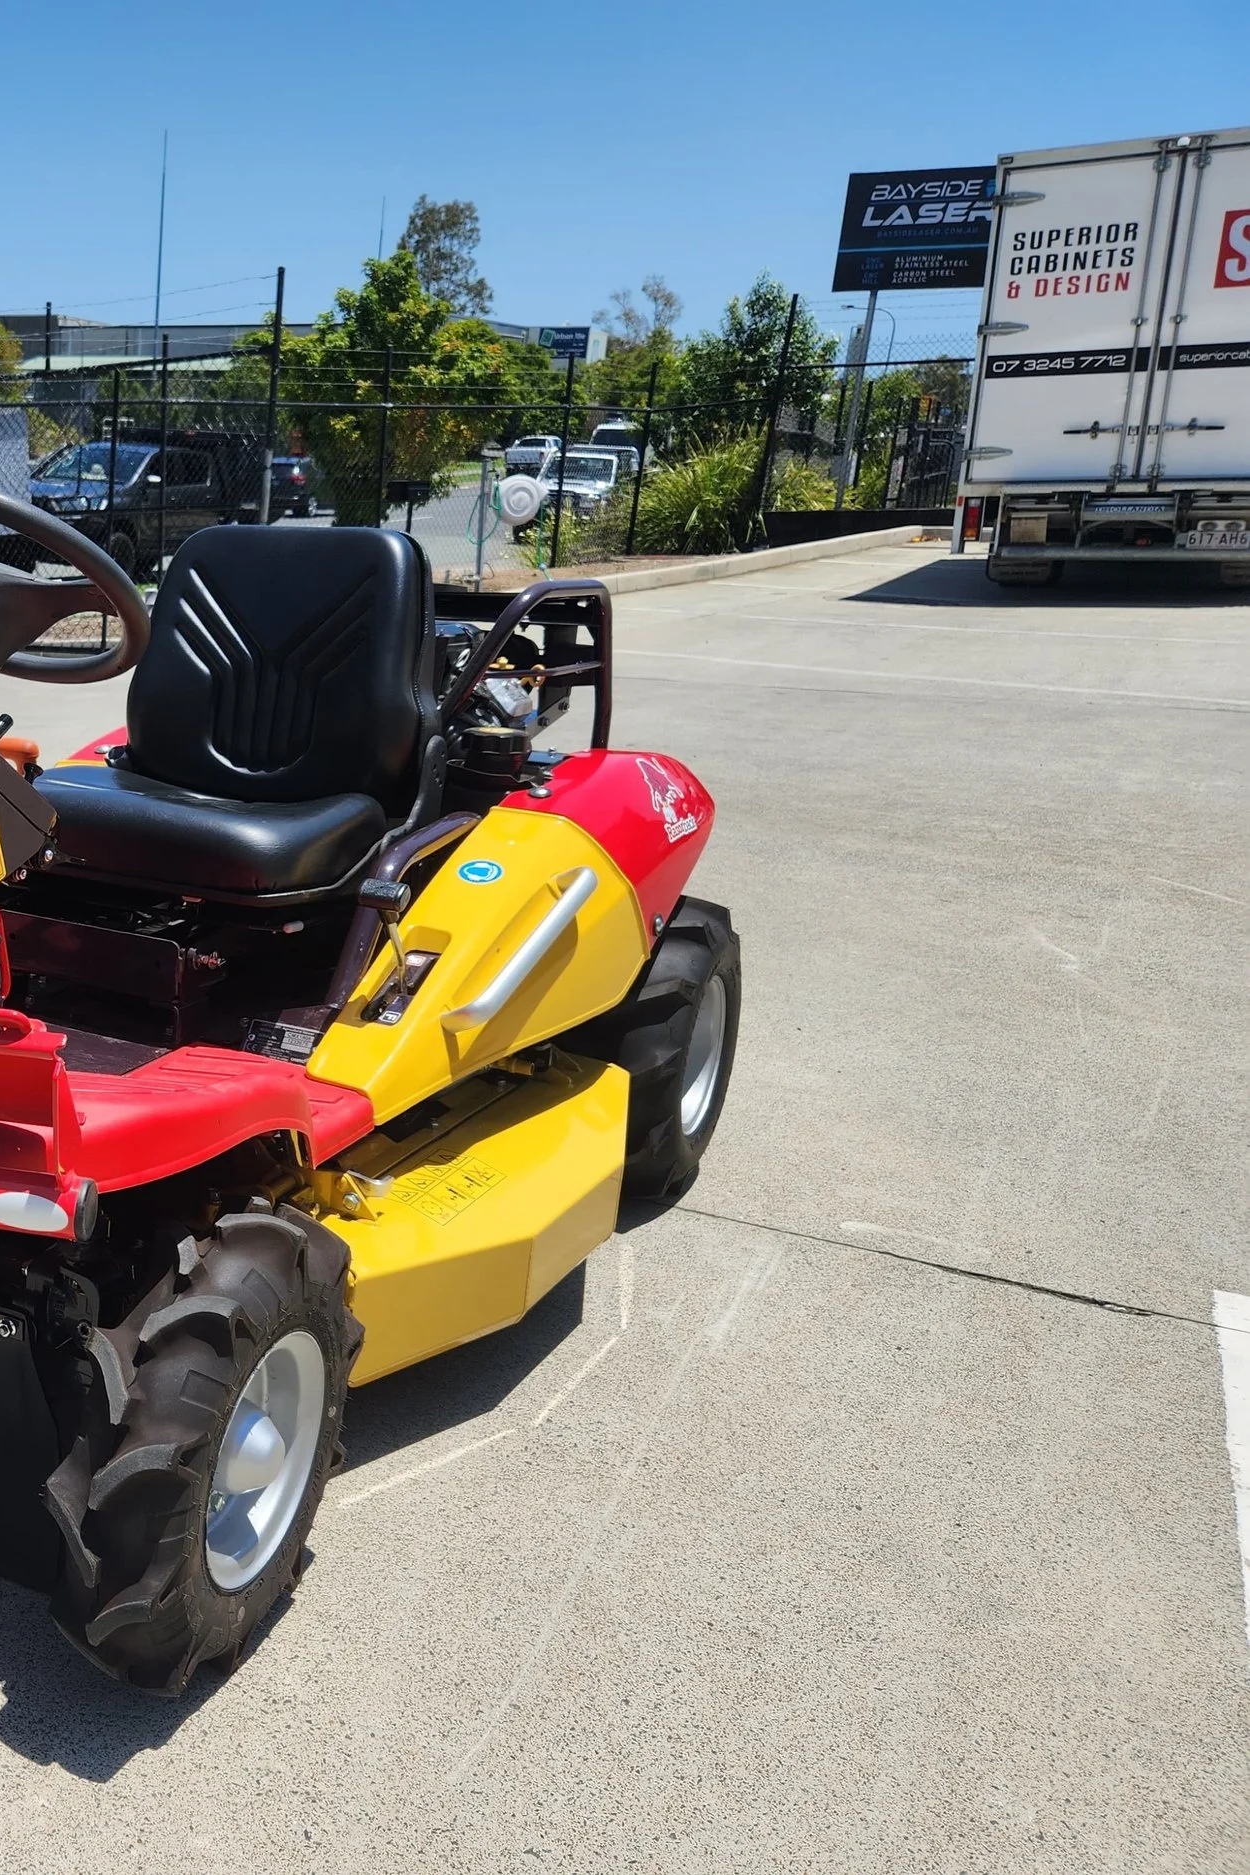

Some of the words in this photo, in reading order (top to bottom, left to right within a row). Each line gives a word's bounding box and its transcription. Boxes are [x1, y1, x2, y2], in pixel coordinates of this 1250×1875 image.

[870, 179, 984, 201] BAYSIDE
[862, 201, 994, 228] LASER
[1013, 222, 1138, 251] SUPERIOR
[894, 261, 943, 269] STAINLESS
[944, 259, 969, 267] STEEL
[895, 254, 944, 262] ALUMINIUM
[1010, 247, 1135, 276] CABINETS
[891, 276, 927, 284] ACRYLIC
[930, 269, 956, 277] STEEL
[1007, 281, 1021, 299] &
[1034, 272, 1130, 297] DESIGN
[992, 359, 1020, 373] 07
[1023, 357, 1075, 372] 3245
[1079, 354, 1126, 369] 7712
